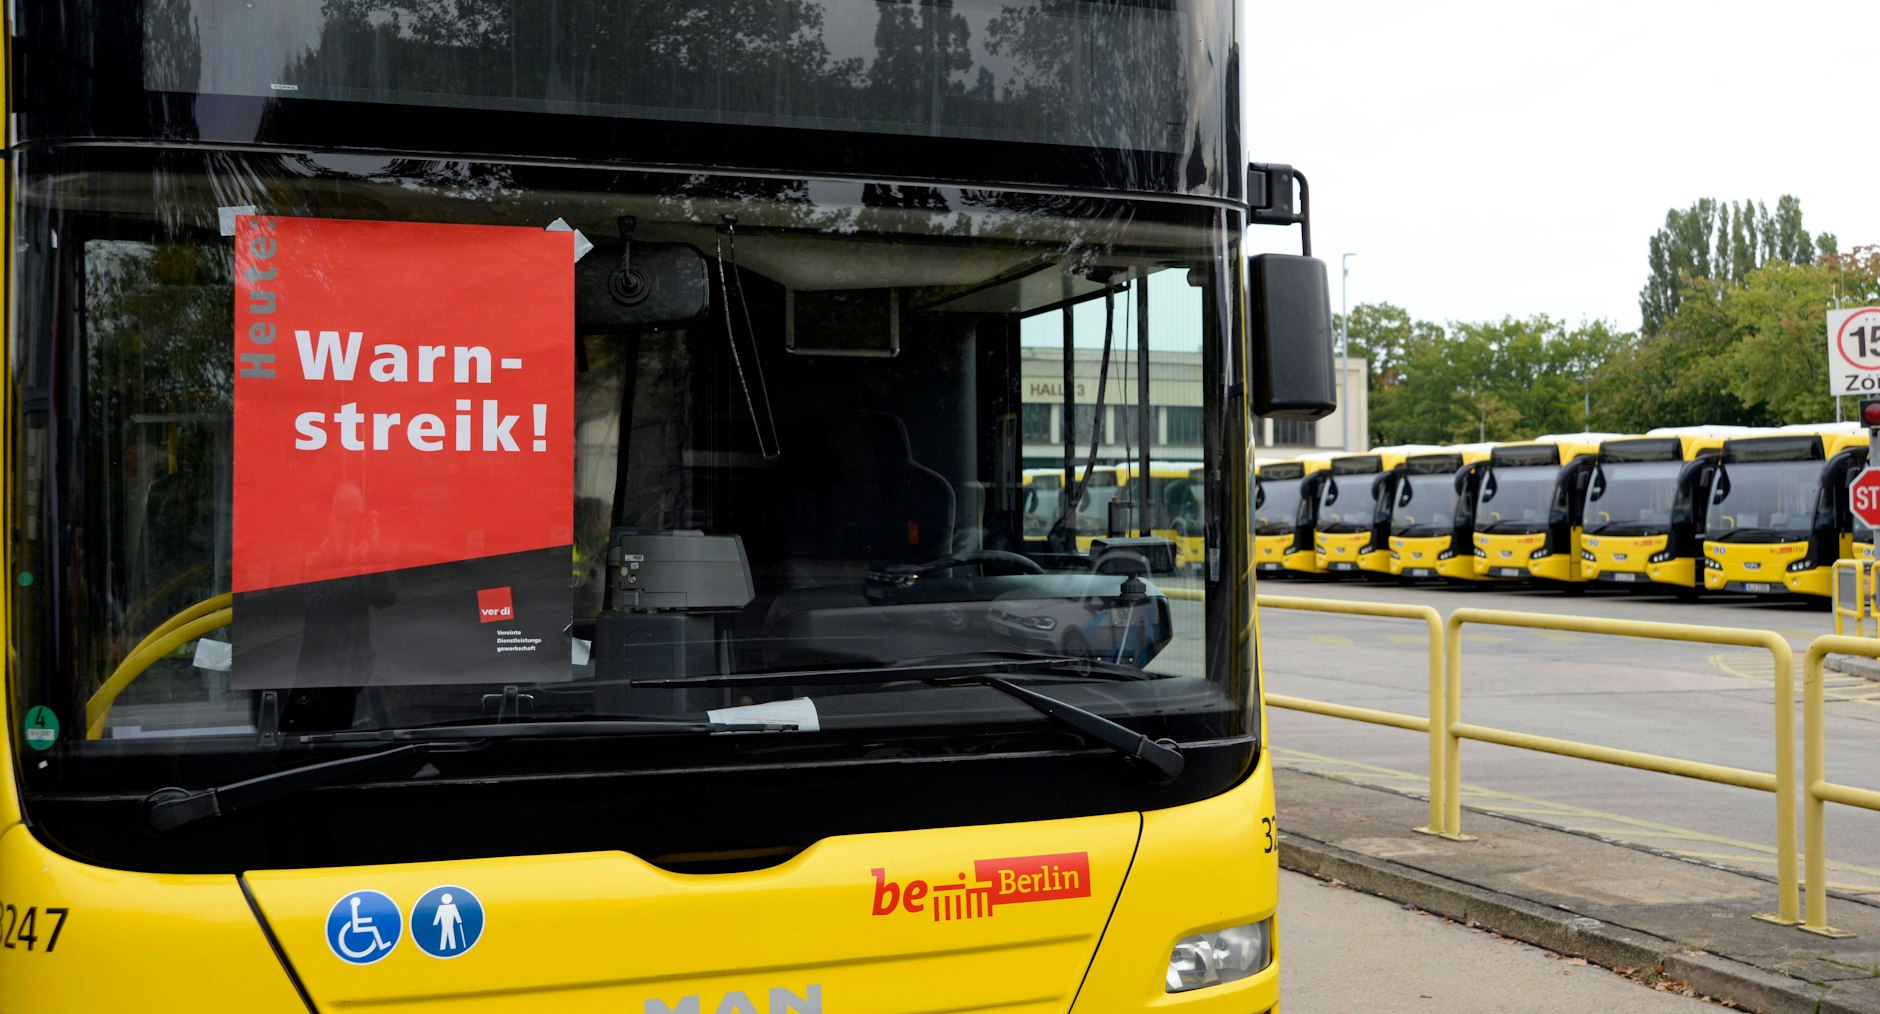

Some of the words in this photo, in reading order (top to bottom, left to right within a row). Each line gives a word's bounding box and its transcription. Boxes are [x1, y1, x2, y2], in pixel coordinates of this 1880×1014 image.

[240, 219, 277, 379] Heute:
[294, 330, 523, 384] Warn-
[1030, 384, 1064, 396] HALL
[1076, 384, 1085, 396] 3
[294, 399, 548, 453] streik!
[35, 707, 45, 728] 4
[870, 867, 928, 917] be
[998, 865, 1079, 895] Berlin
